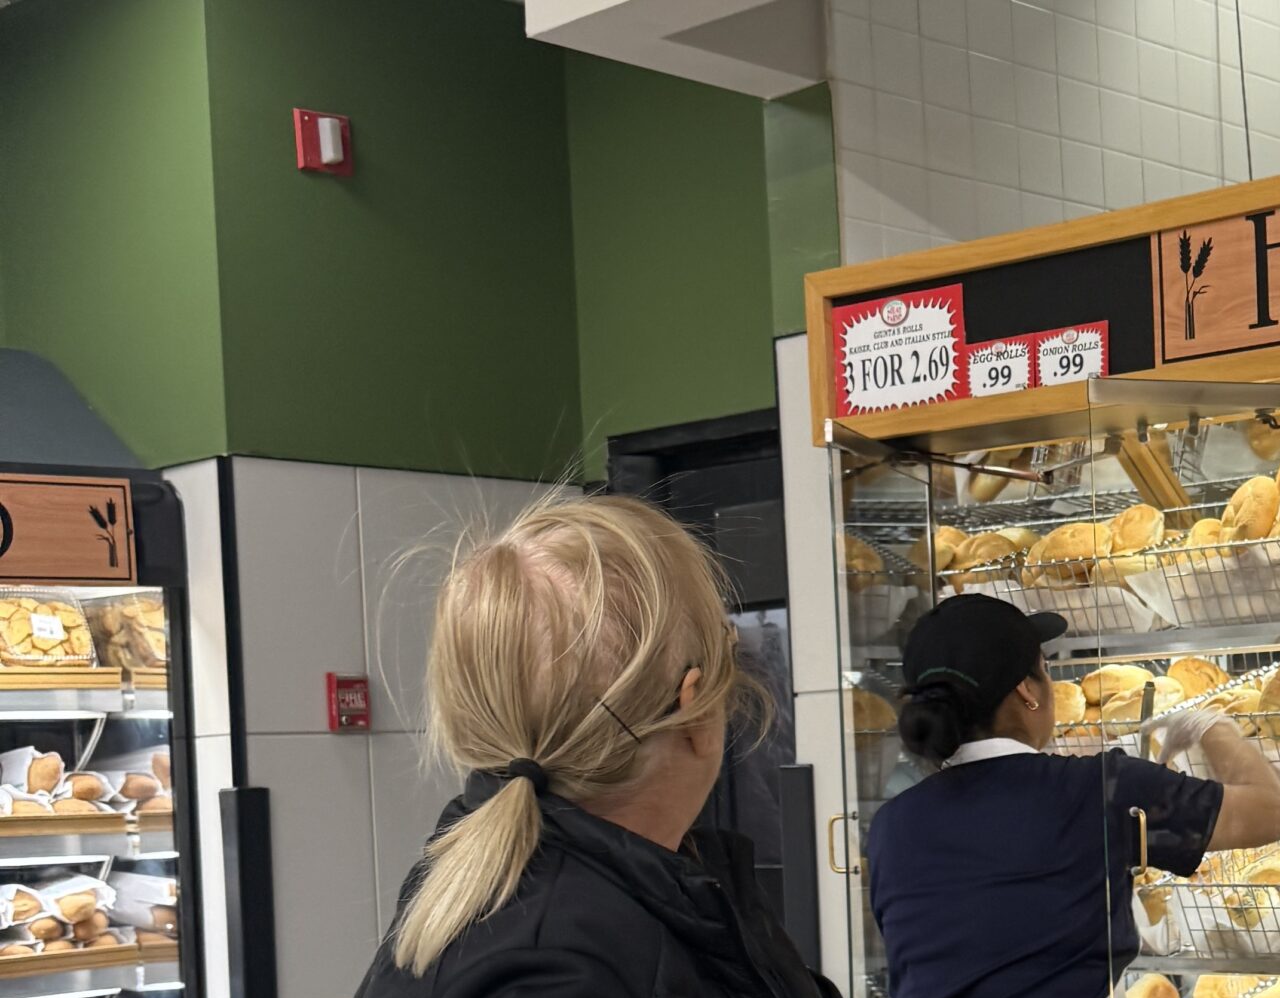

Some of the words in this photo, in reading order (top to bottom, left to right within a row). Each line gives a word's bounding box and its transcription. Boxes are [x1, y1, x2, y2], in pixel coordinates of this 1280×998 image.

[903, 323, 923, 334] ROLLS
[890, 338, 904, 348] AND
[905, 334, 930, 345] ITALIAN
[1042, 345, 1070, 357] ONION
[1071, 340, 1099, 354] ROLLS
[972, 352, 993, 365] EGG
[995, 347, 1027, 362] ROLLS
[1053, 353, 1084, 377] .99
[861, 353, 906, 391] FOR
[911, 345, 950, 383] 2.69
[982, 365, 1012, 388] .99
